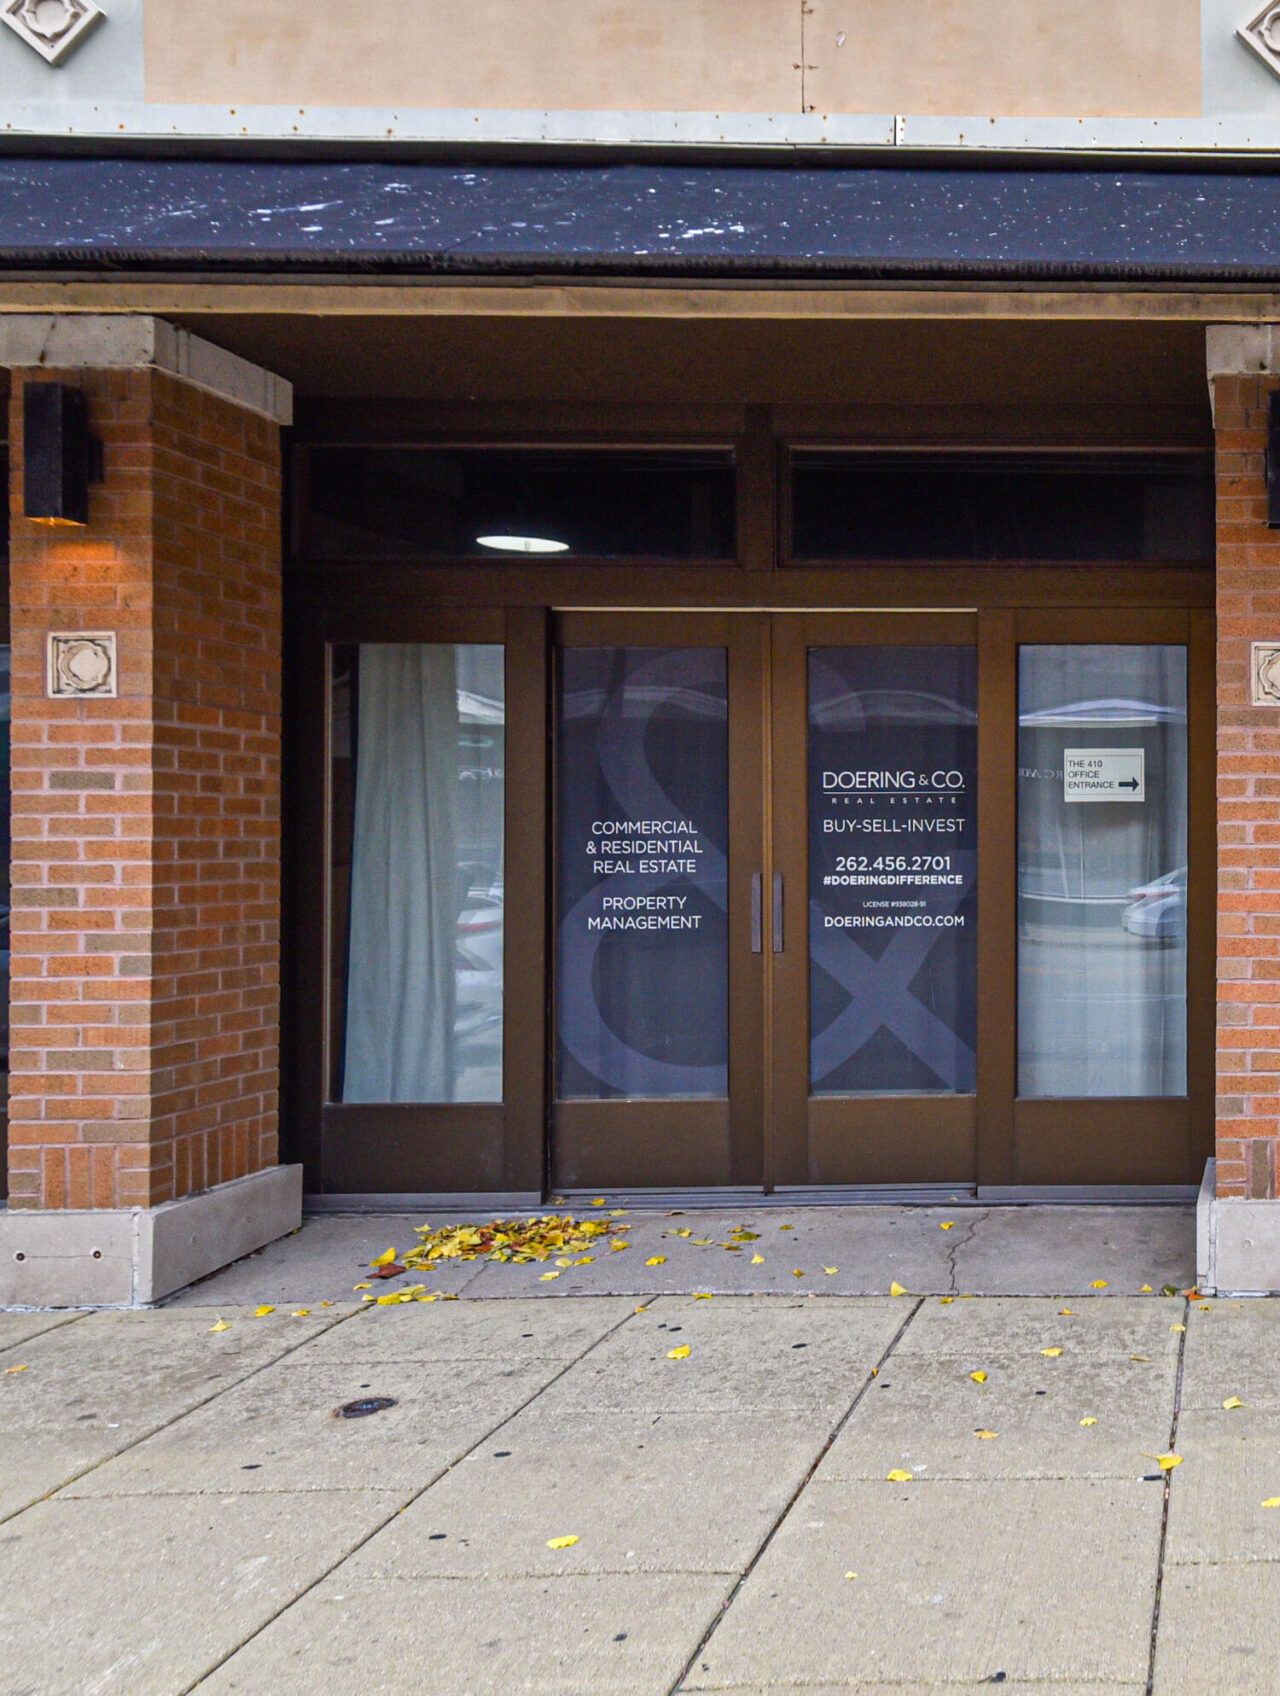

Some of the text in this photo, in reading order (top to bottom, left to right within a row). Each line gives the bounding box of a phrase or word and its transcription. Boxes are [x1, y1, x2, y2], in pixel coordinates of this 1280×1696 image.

[1068, 760, 1103, 768] THE 410
[823, 770, 966, 789] DOERING & CO.
[1068, 770, 1100, 779] OFFICE
[1068, 781, 1115, 789] ENTRANCE
[591, 820, 698, 835] COMMERCIAL
[823, 818, 965, 833] BUY-SELL-INVEST
[586, 839, 703, 855] & RESIDENTIAL
[593, 859, 696, 874] REAL ESTATE
[835, 856, 951, 872] 262.456.2701
[823, 873, 963, 886] #DOERINGDIFFERENCE
[602, 896, 687, 911] PROPERTY
[587, 915, 702, 931] MANAGEMENT
[824, 914, 965, 928] DOERINGANDCO.COM
